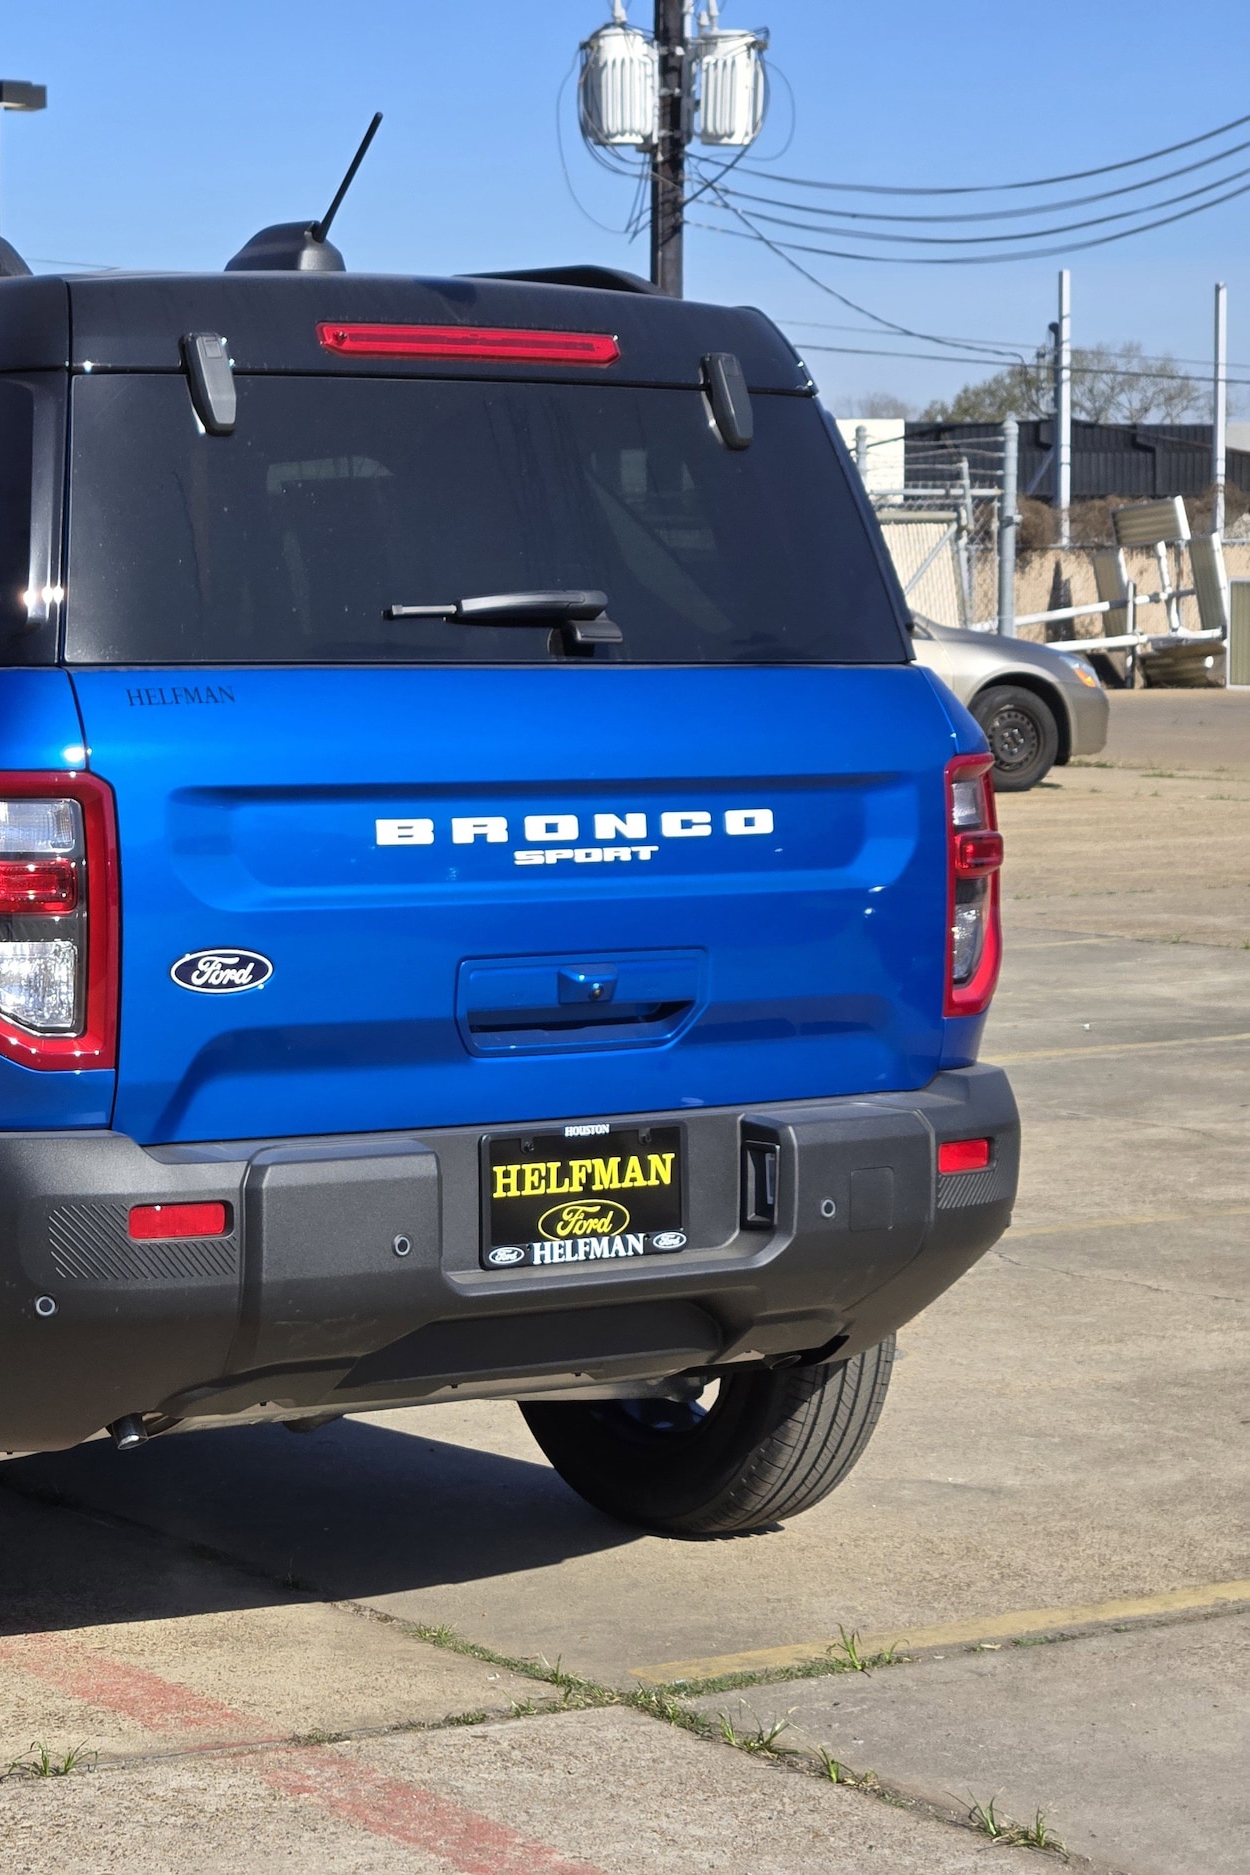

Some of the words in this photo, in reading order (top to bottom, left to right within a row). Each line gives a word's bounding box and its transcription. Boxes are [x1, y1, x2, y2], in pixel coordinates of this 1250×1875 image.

[126, 685, 236, 706] HELFMAN
[374, 808, 774, 846] BRONCO
[513, 845, 659, 866] SPORT
[191, 956, 255, 985] Ford
[564, 1123, 610, 1138] HOUSTON
[492, 1152, 676, 1198] HELFMAN
[556, 1205, 615, 1237] Ford
[532, 1233, 646, 1266] HELFMAN
